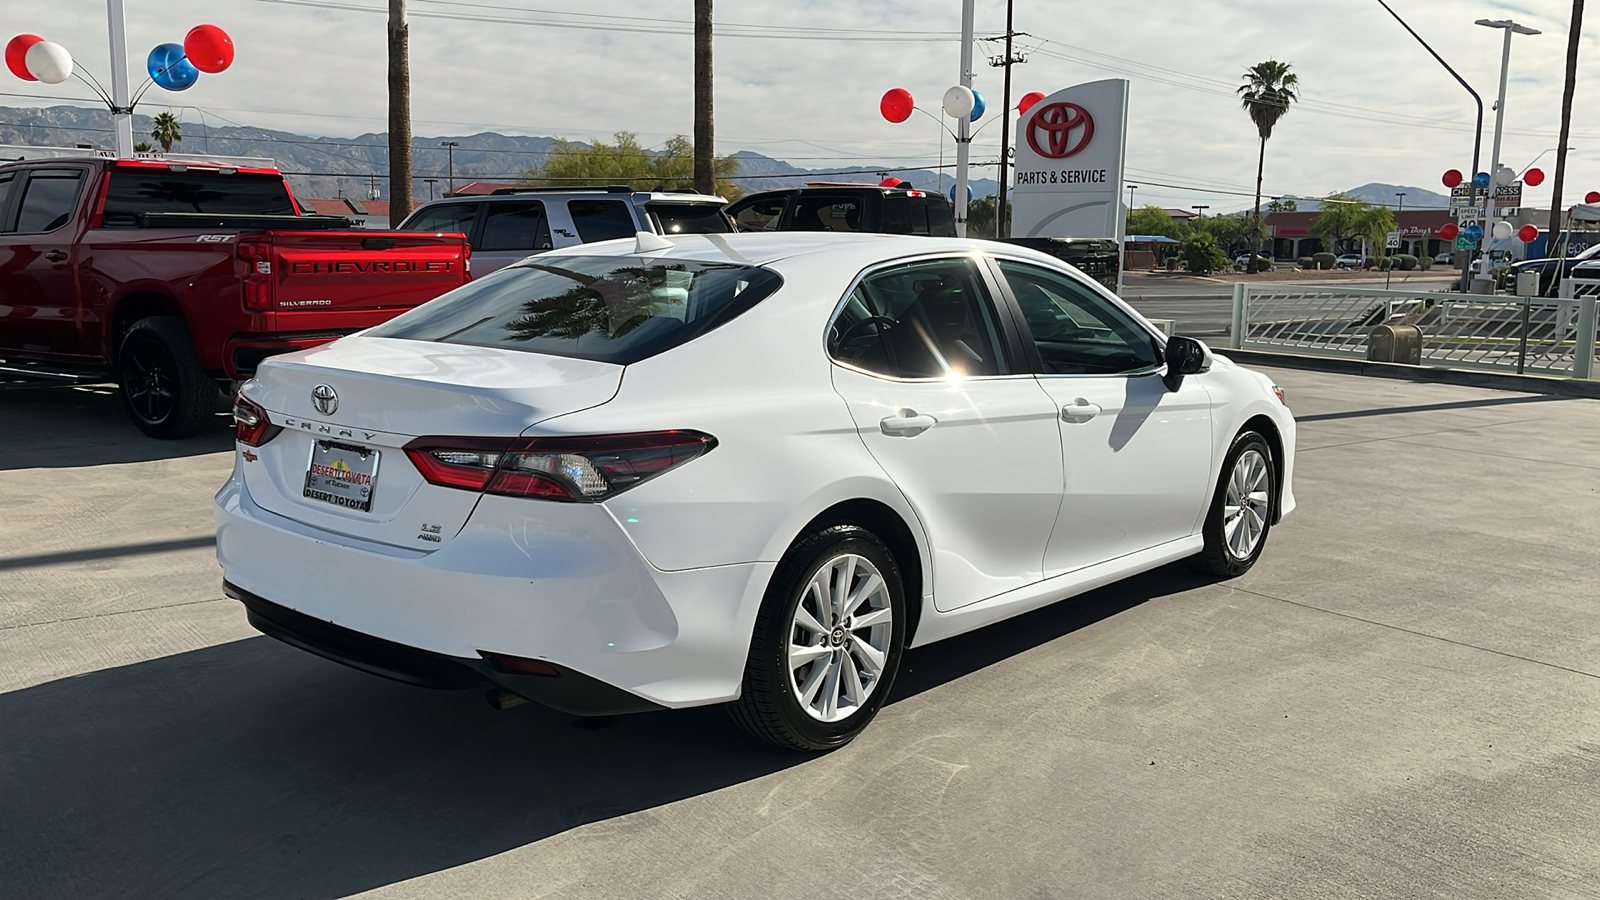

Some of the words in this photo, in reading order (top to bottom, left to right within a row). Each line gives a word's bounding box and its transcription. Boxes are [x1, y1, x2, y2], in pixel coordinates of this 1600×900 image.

[1017, 171, 1047, 184] PARTS
[1049, 171, 1058, 183] &
[1060, 169, 1106, 183] SERVICE
[1483, 187, 1519, 195] FNESS
[1410, 227, 1431, 235] Boys
[196, 234, 236, 242] RST
[292, 261, 455, 274] CHEVROLET
[285, 419, 376, 440] CAMRY
[312, 463, 339, 478] DESERT
[341, 469, 371, 486] TOYOTA
[332, 480, 350, 489] Tucson
[306, 489, 333, 503] DESERT
[334, 496, 365, 511] TOYOTA
